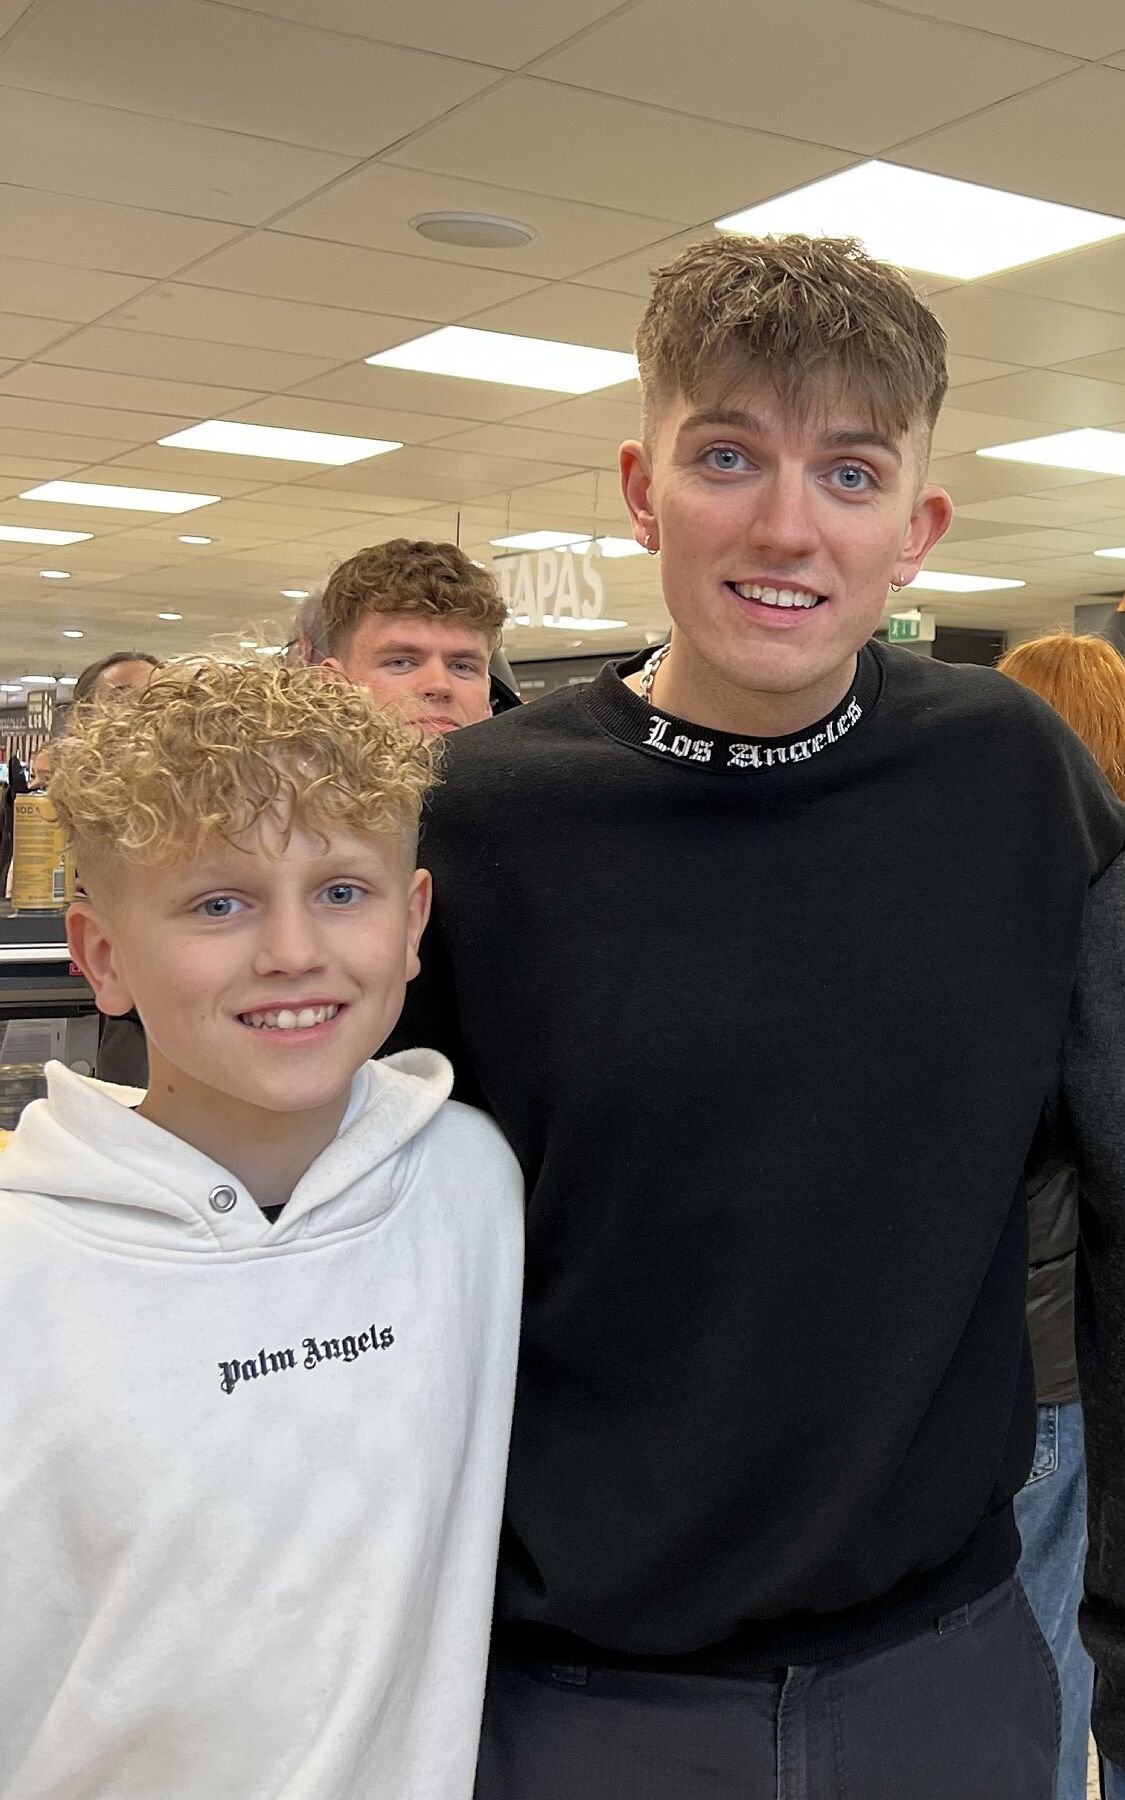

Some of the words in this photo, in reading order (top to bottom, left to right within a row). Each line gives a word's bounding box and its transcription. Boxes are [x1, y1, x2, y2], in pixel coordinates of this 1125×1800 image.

[493, 541, 603, 629] TAPAS
[642, 715, 714, 763] Los
[727, 696, 863, 768] Angeles
[218, 1348, 298, 1395] Palm
[302, 1323, 395, 1370] Angels
